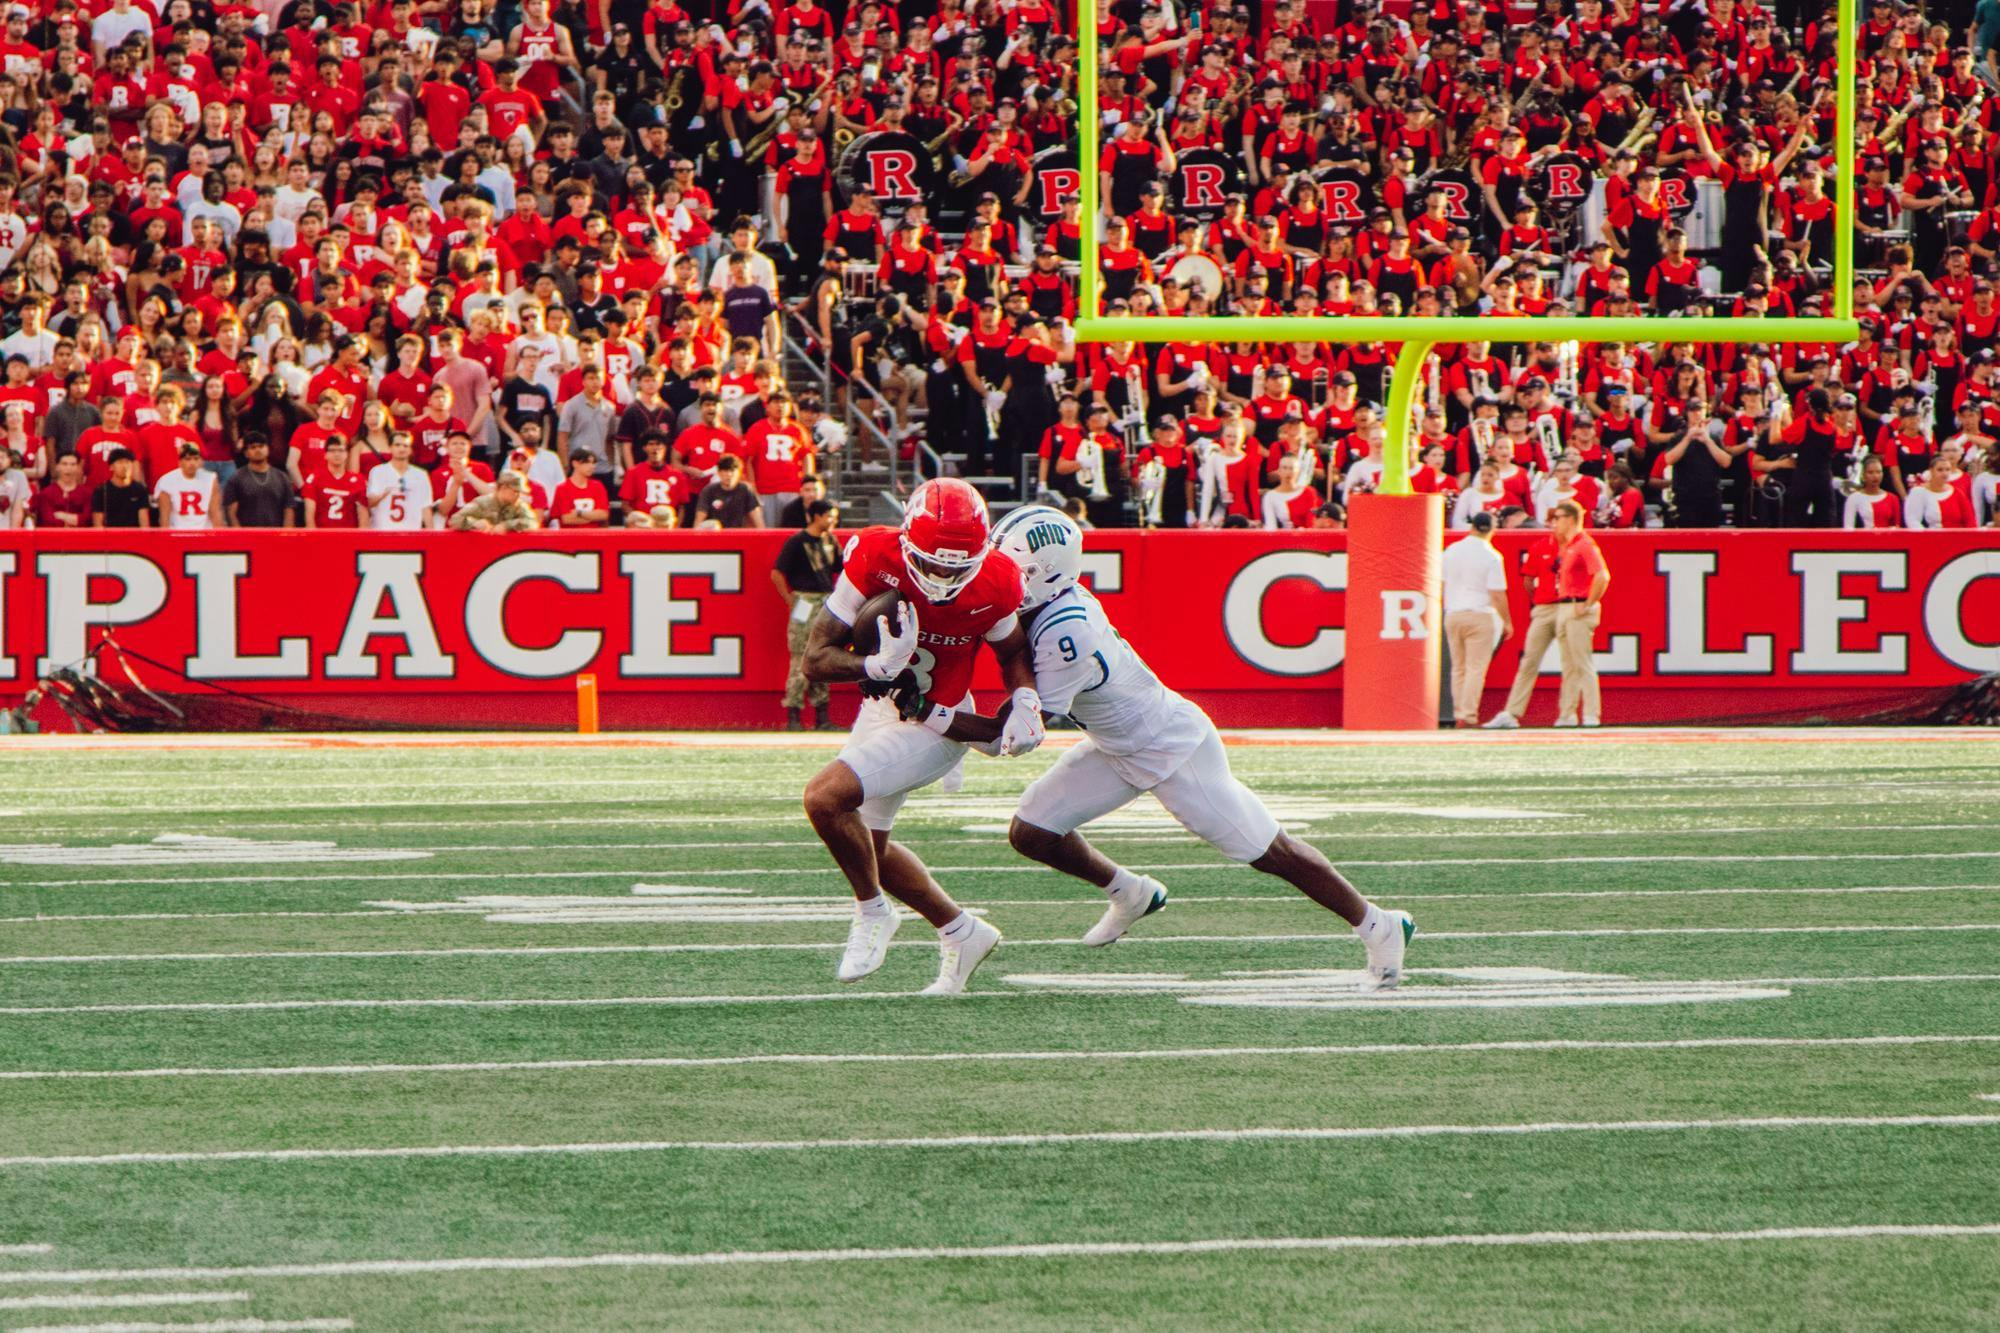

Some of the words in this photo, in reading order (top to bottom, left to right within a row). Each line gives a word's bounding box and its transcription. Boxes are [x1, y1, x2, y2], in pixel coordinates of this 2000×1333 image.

[867, 150, 921, 199] R
[1182, 164, 1227, 207] R
[1548, 164, 1585, 198] R
[1323, 181, 1366, 221] R
[1433, 181, 1470, 219] R
[1659, 179, 1689, 208] R
[192, 265, 210, 289] 17
[607, 355, 629, 374] R
[766, 434, 793, 461] R
[180, 491, 205, 516] R
[646, 479, 671, 504] R
[328, 495, 344, 520] 2
[390, 495, 405, 522] 5
[843, 534, 860, 563] 8
[1026, 522, 1067, 553] OHIO
[0, 551, 744, 680] PLACE
[1380, 590, 1430, 640] R
[917, 630, 972, 646] GERS
[1057, 635, 1078, 663] 9
